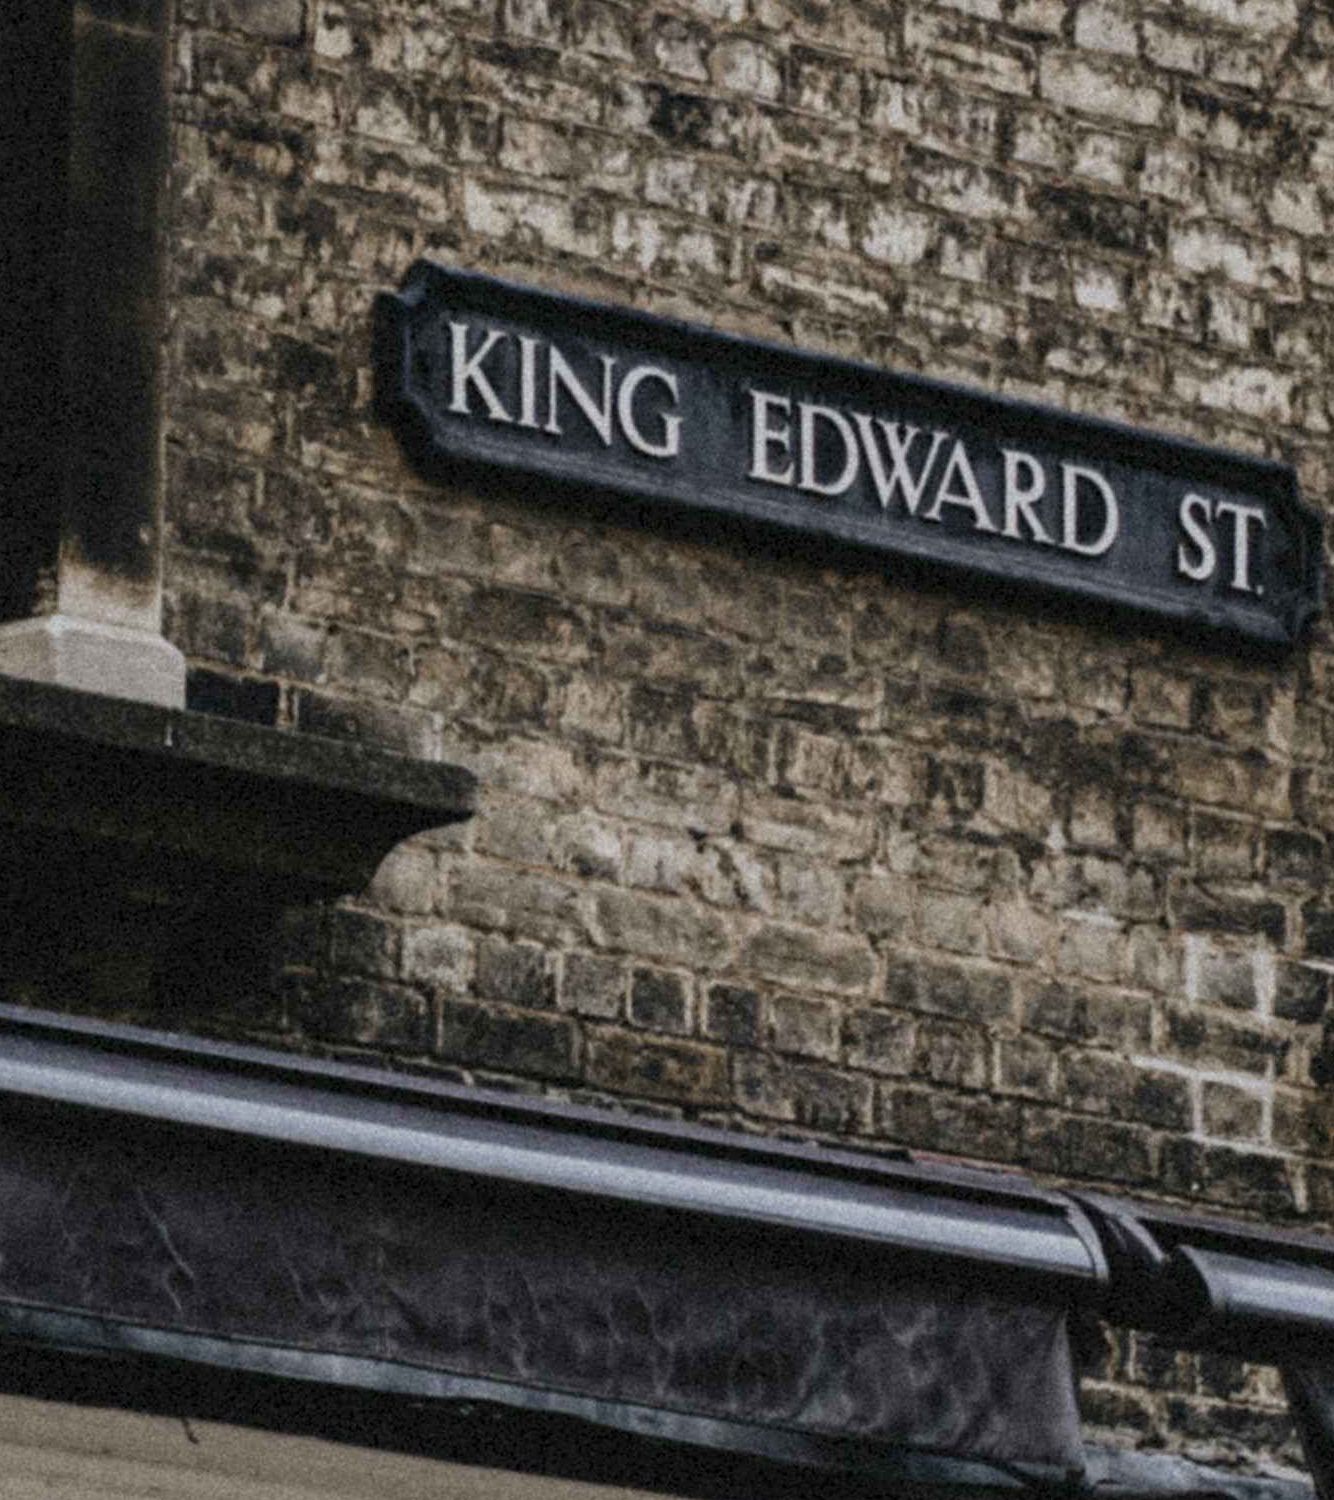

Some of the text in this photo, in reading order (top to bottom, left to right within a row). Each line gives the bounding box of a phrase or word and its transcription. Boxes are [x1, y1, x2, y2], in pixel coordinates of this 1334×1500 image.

[449, 322, 1267, 597] KING EDWARD ST.
